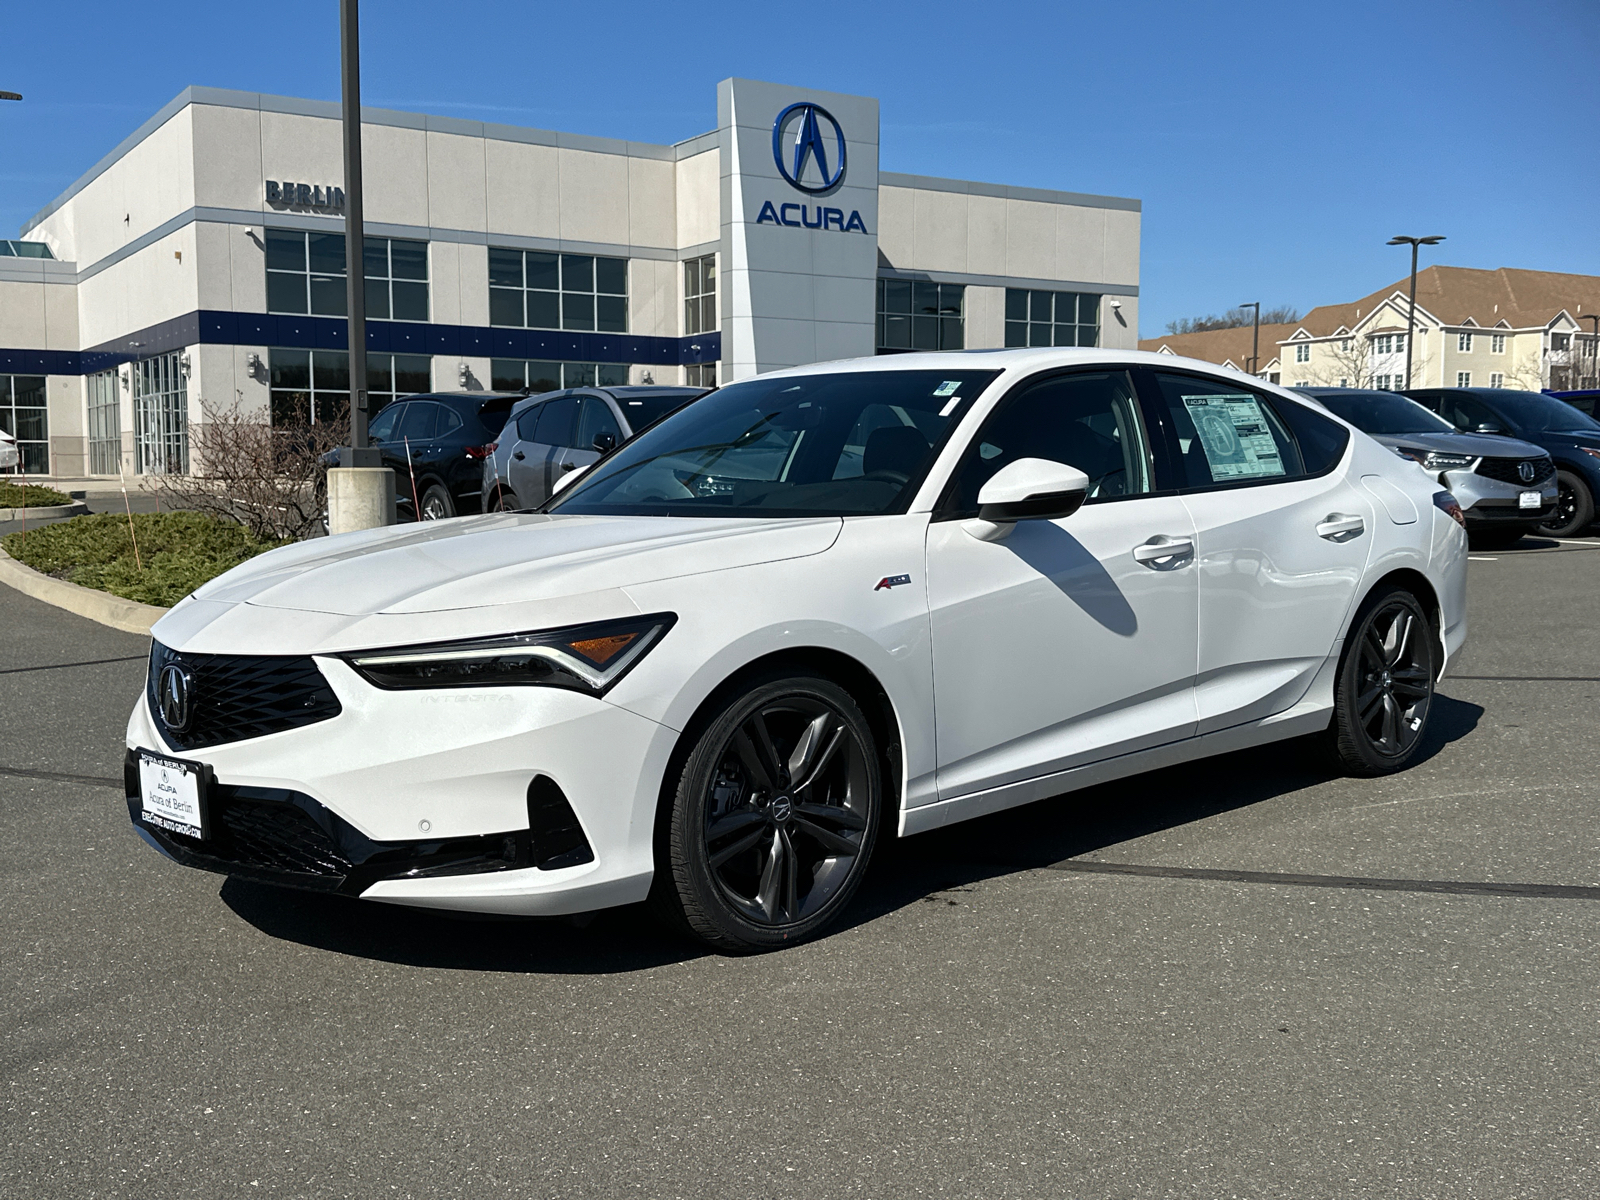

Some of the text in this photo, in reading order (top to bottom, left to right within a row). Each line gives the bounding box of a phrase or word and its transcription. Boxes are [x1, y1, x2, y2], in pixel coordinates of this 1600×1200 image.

[265, 180, 346, 208] BERLIN
[756, 200, 868, 235] ACURA
[420, 694, 514, 704] INTEGRA
[157, 783, 178, 794] ACURA
[149, 790, 165, 806] Acura
[165, 798, 172, 808] of
[172, 798, 193, 814] Berlin
